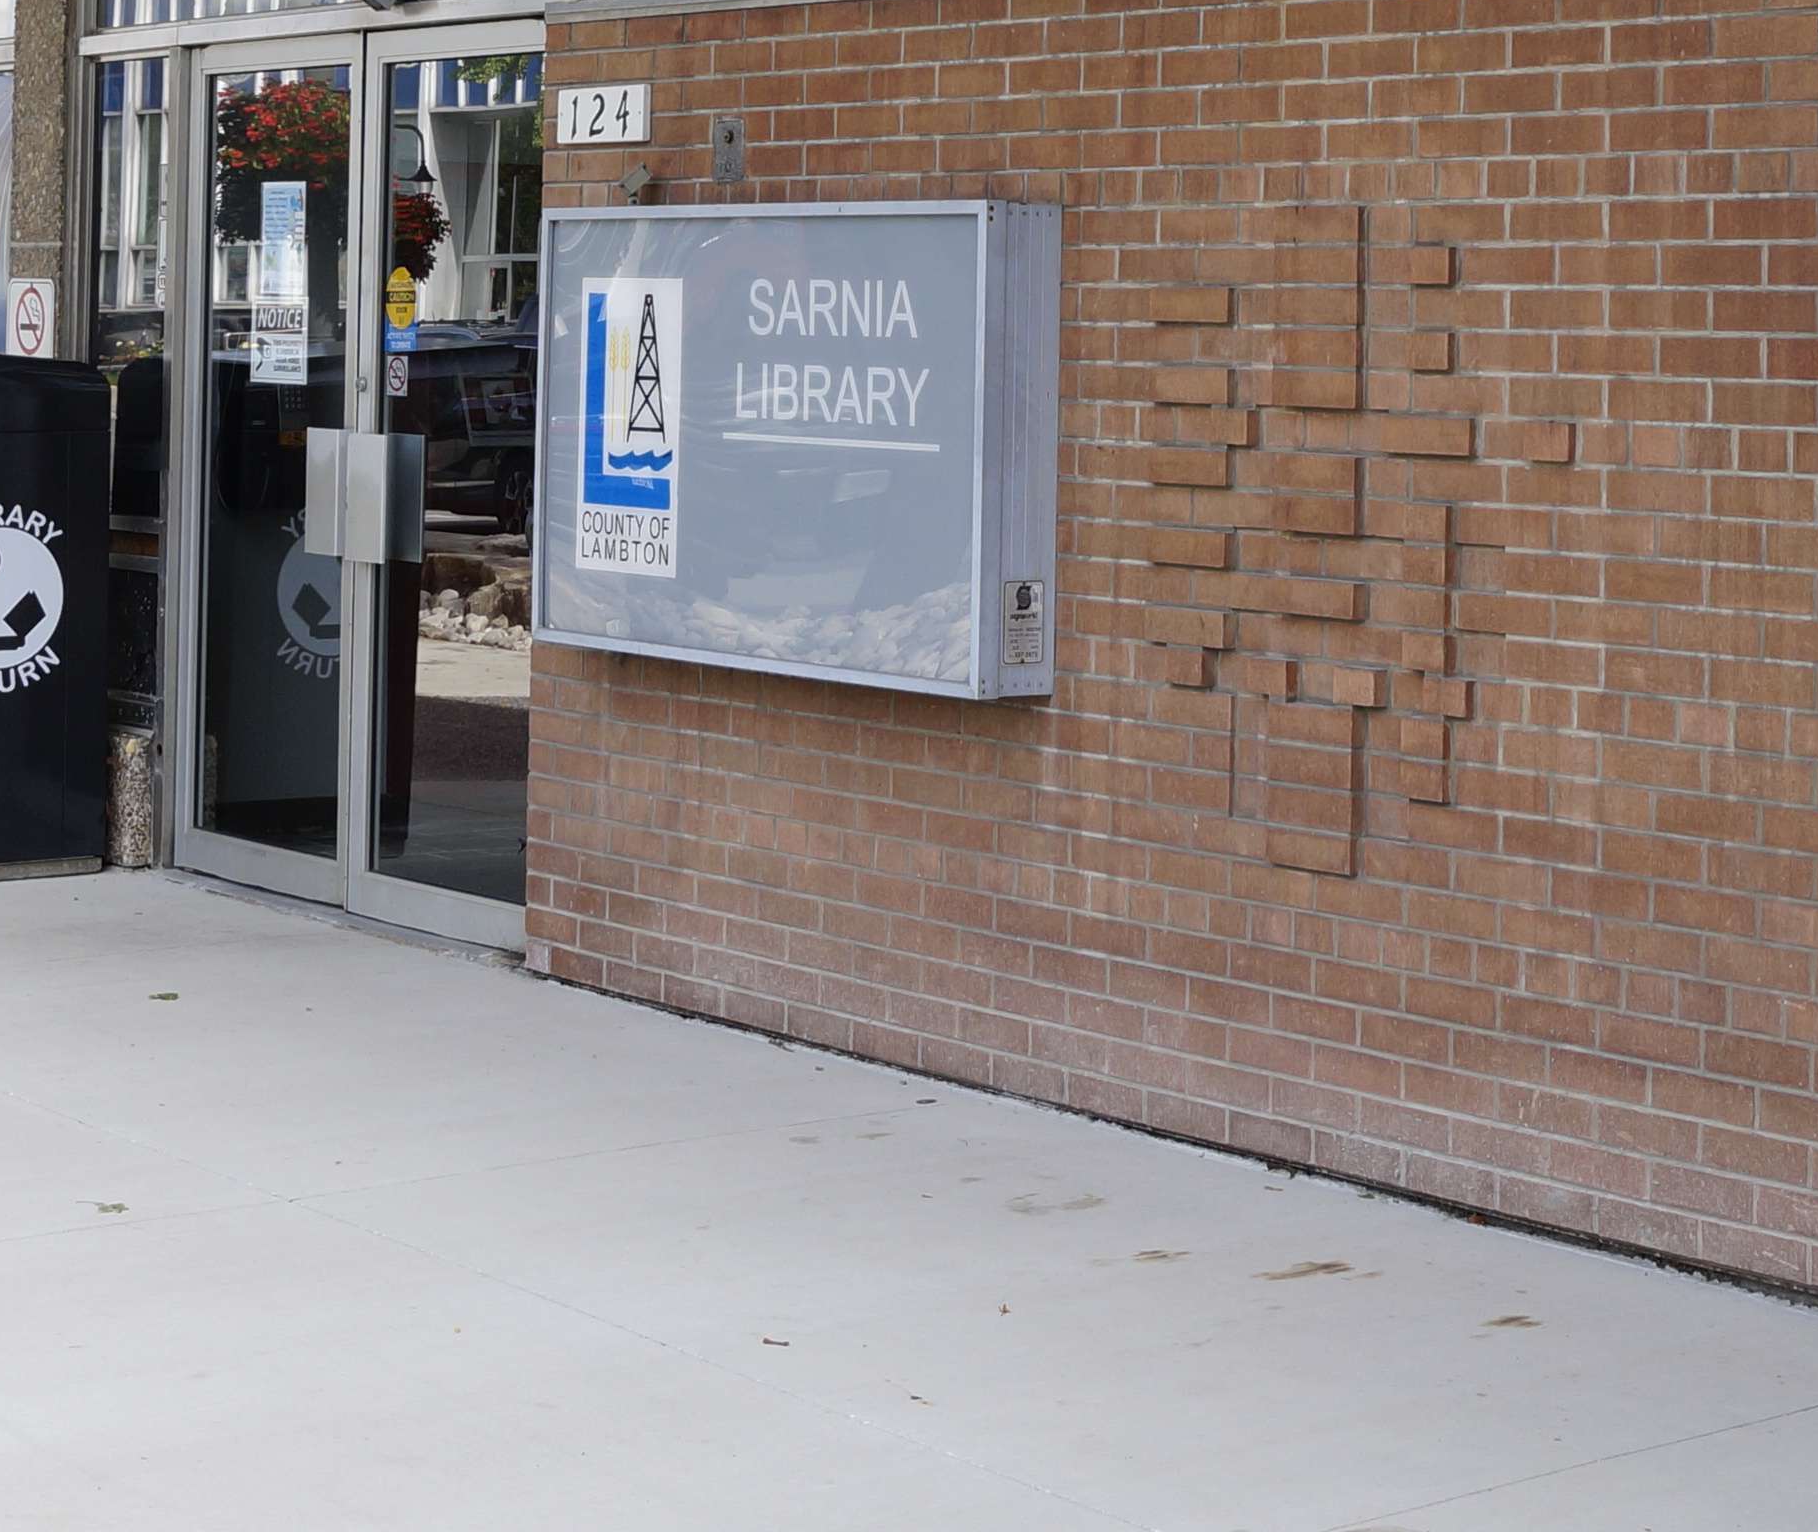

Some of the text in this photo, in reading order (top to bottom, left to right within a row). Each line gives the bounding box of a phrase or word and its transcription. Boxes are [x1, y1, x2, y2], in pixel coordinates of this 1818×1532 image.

[570, 89, 630, 140] 124
[257, 307, 302, 328] NOTICE
[748, 278, 918, 339] SARNIA
[735, 362, 930, 428] LIBRARY
[582, 511, 671, 540] COUNTY OF
[581, 536, 669, 566] LAMBTON
